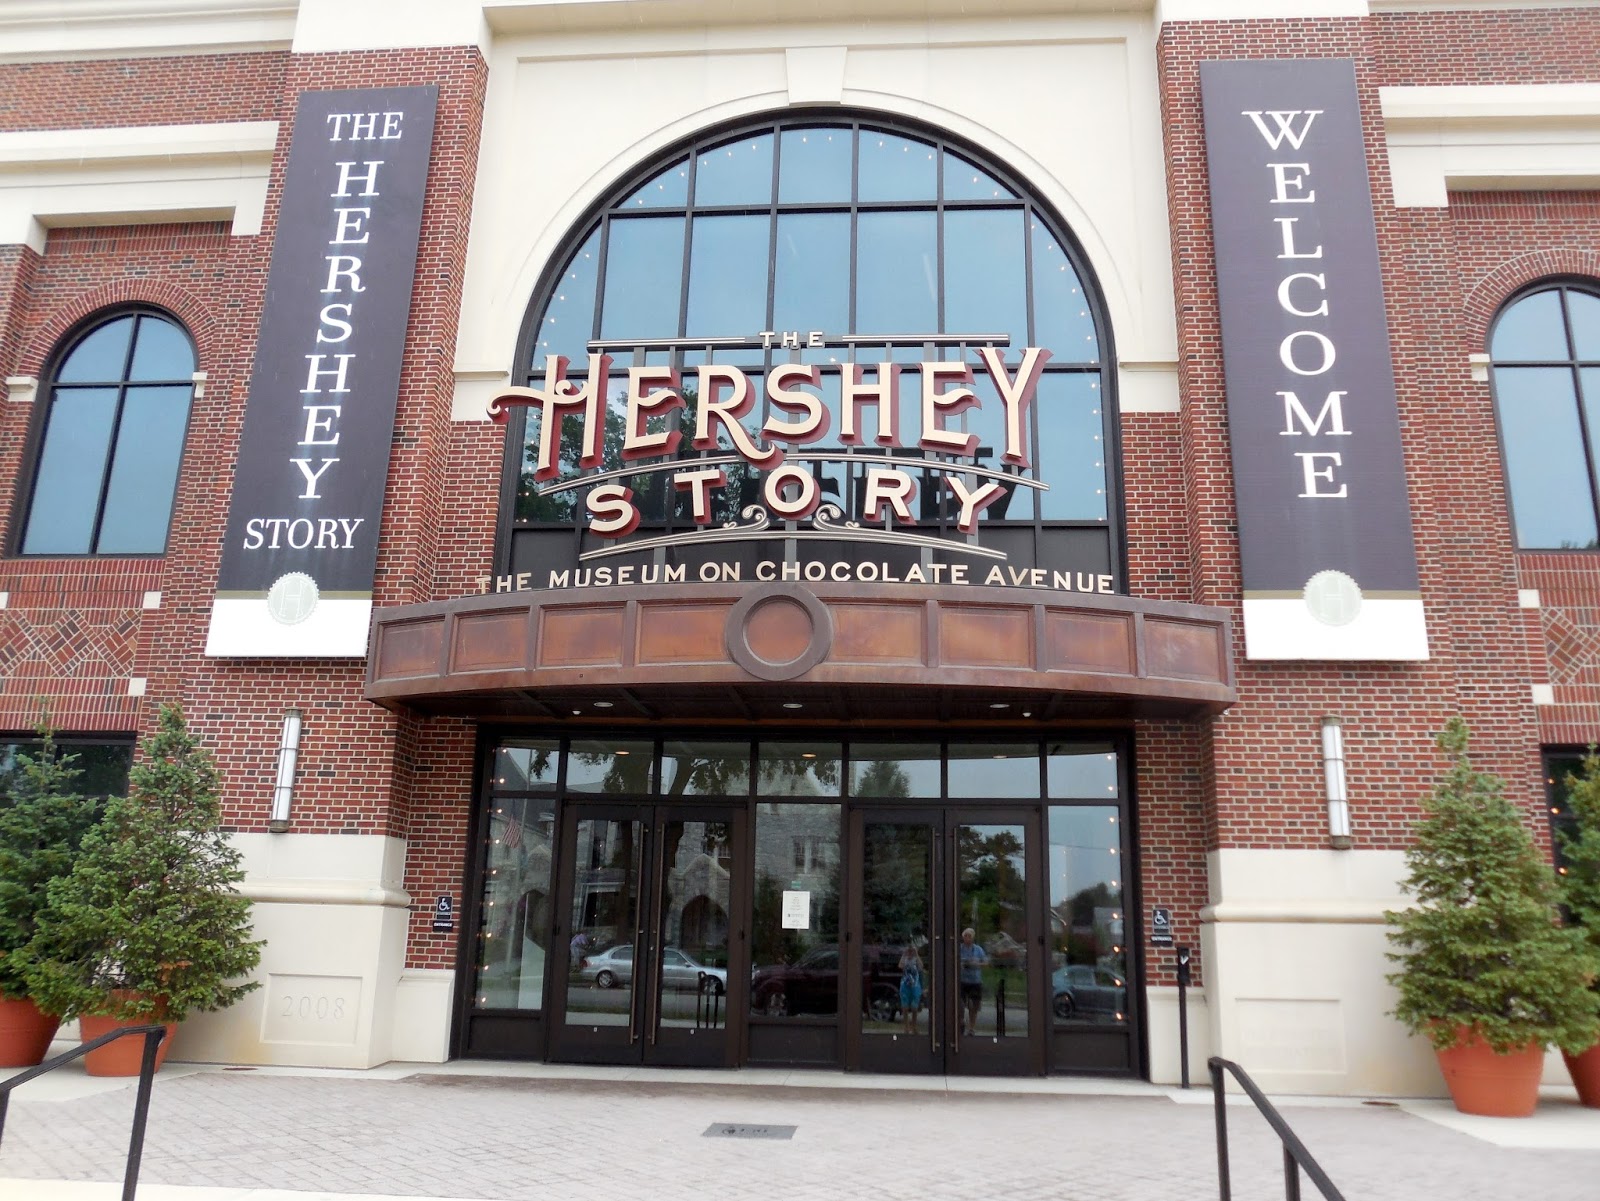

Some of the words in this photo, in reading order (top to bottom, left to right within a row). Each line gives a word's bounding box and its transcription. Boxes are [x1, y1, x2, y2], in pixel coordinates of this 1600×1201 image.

[327, 111, 404, 141] THE
[1241, 110, 1352, 499] WELCOME
[289, 160, 385, 499] HERSHEY
[759, 330, 824, 349] THE
[486, 346, 1050, 481] HERSHEY
[586, 465, 1007, 538] STORY
[243, 518, 364, 550] STORY
[476, 572, 532, 594] THE
[549, 563, 686, 588] MUSEUM
[700, 561, 741, 582] ON
[755, 560, 969, 585] CHOCOLATE
[984, 565, 1115, 594] AVENUE
[281, 995, 346, 1020] 2008
